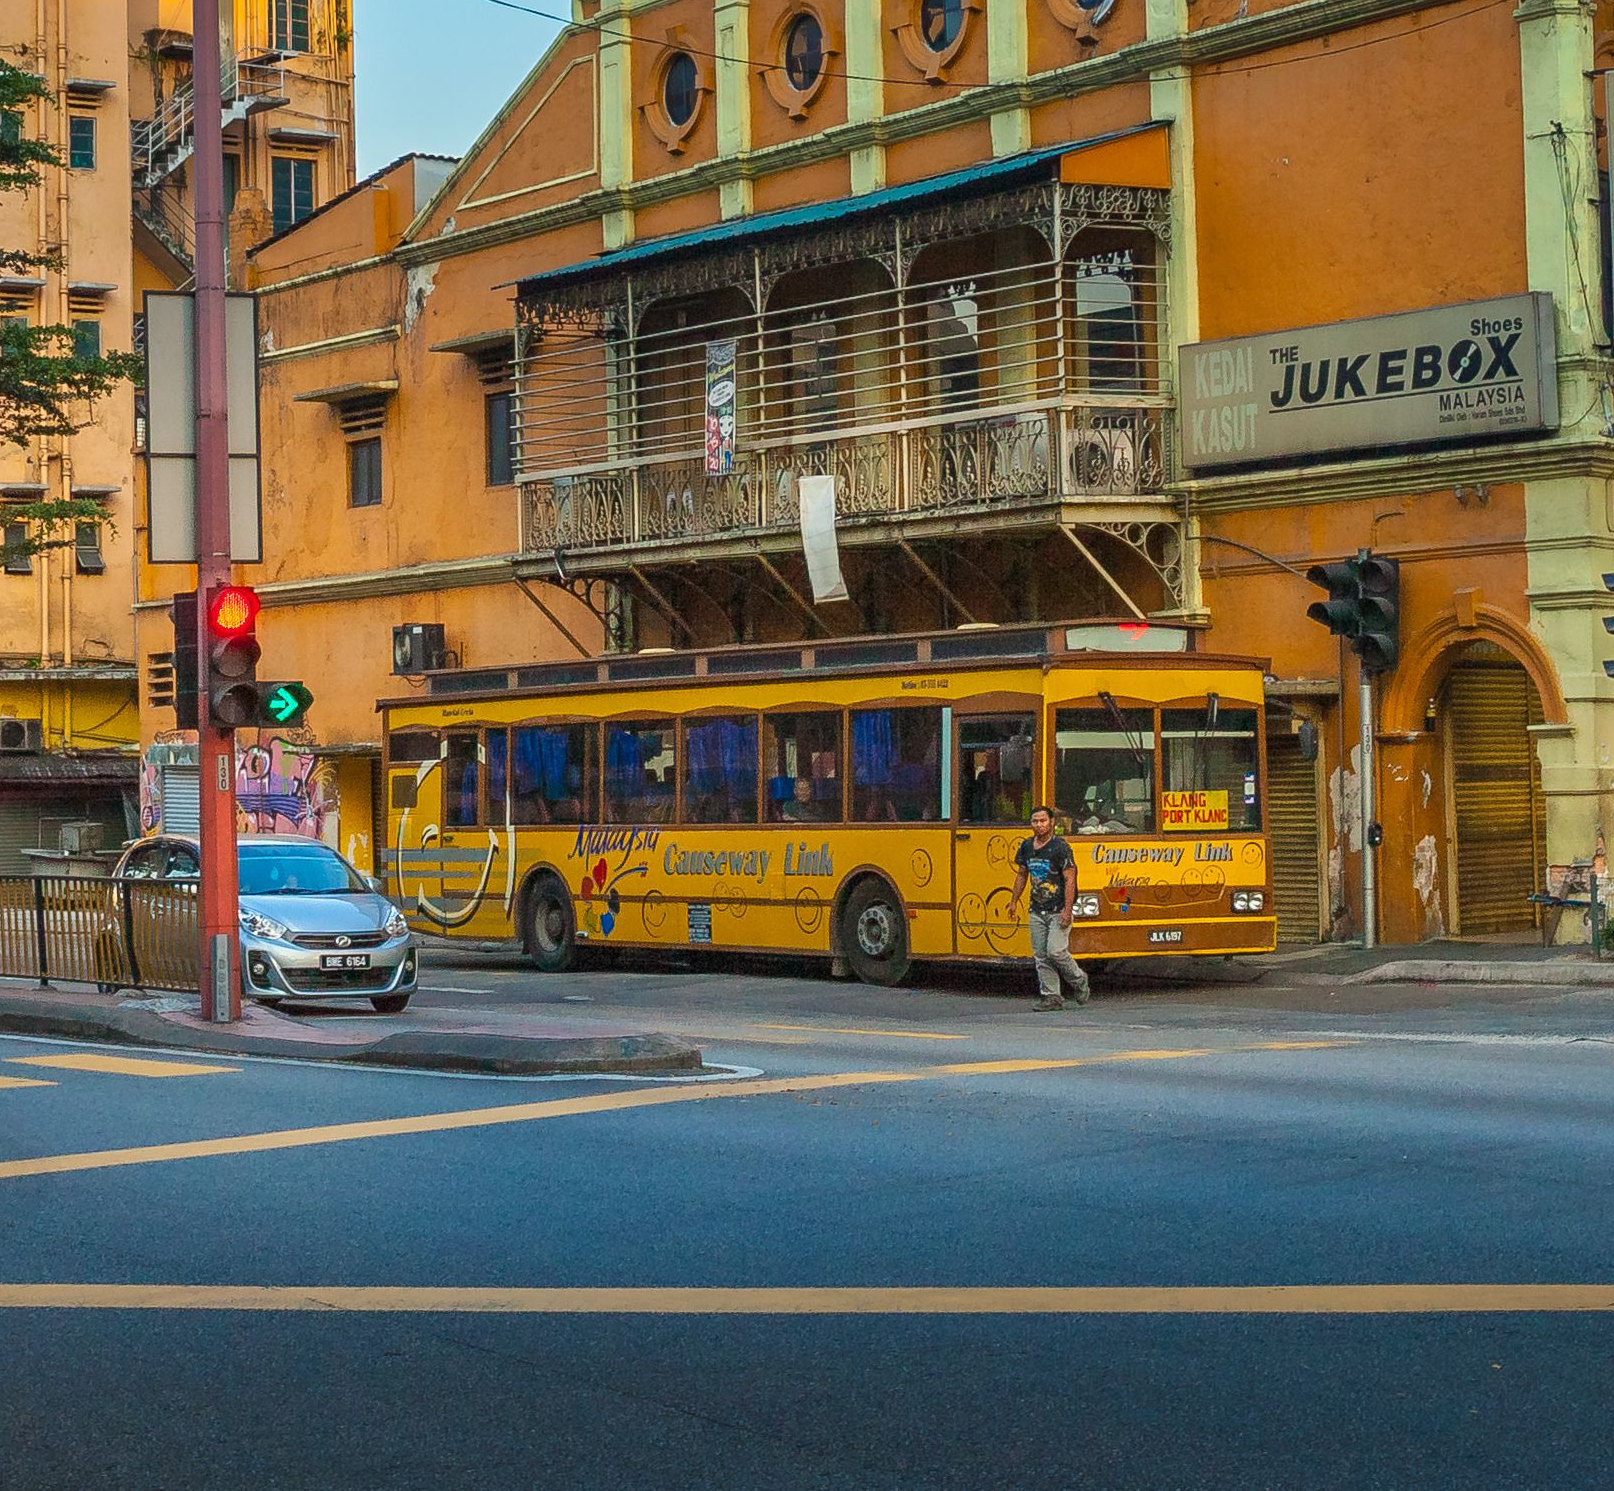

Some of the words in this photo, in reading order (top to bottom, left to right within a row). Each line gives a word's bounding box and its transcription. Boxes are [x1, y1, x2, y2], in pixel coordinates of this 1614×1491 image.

[1470, 317, 1523, 336] Shoes
[1270, 346, 1298, 364] THE
[1195, 346, 1254, 399] KEDAI
[1271, 333, 1521, 407] JUKEBOX
[1439, 386, 1525, 411] MALAYSIA
[1192, 403, 1258, 455] KASUT
[220, 757, 228, 790] 130
[1163, 793, 1206, 808] KLANG
[1163, 809, 1191, 824] PORT
[568, 824, 661, 872] Malaysia
[663, 843, 772, 884] Causeway
[784, 841, 834, 876] Link
[1091, 844, 1185, 867] Causeway
[1194, 843, 1234, 862] Link
